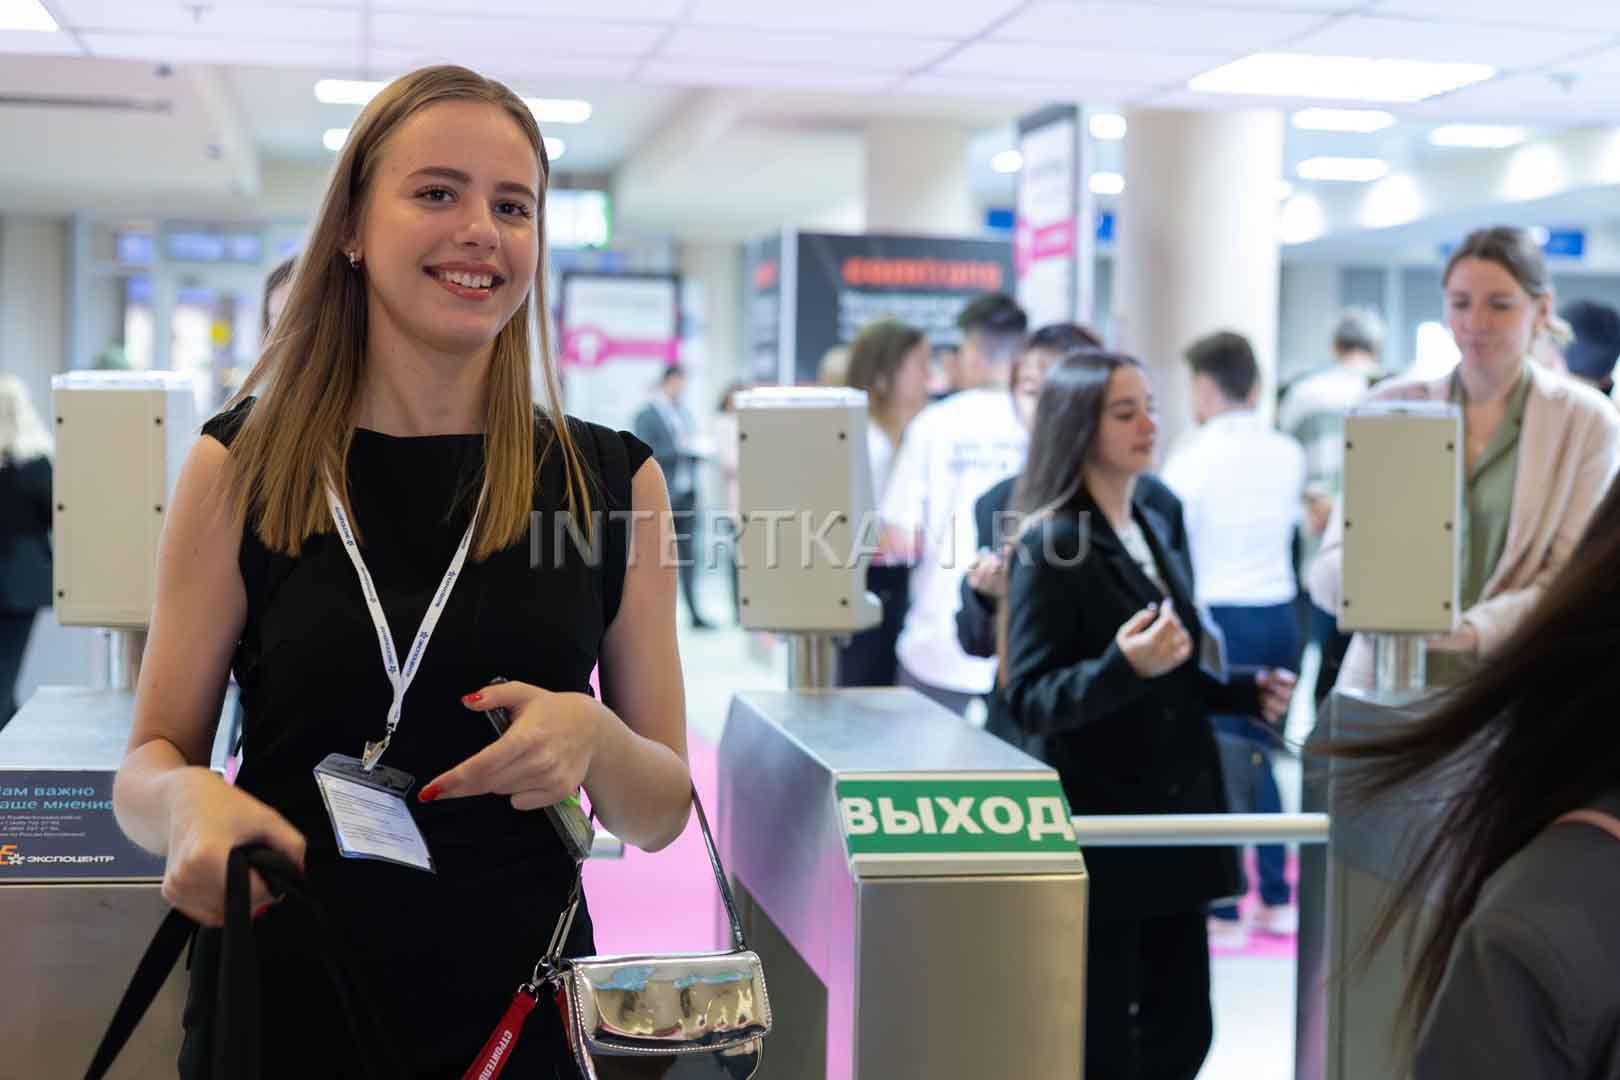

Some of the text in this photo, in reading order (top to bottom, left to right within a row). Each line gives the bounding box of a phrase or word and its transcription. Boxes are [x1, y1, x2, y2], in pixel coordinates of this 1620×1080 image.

[0, 787, 95, 797] ам важно
[0, 801, 38, 809] аше
[841, 797, 1076, 841] ВЫХОД
